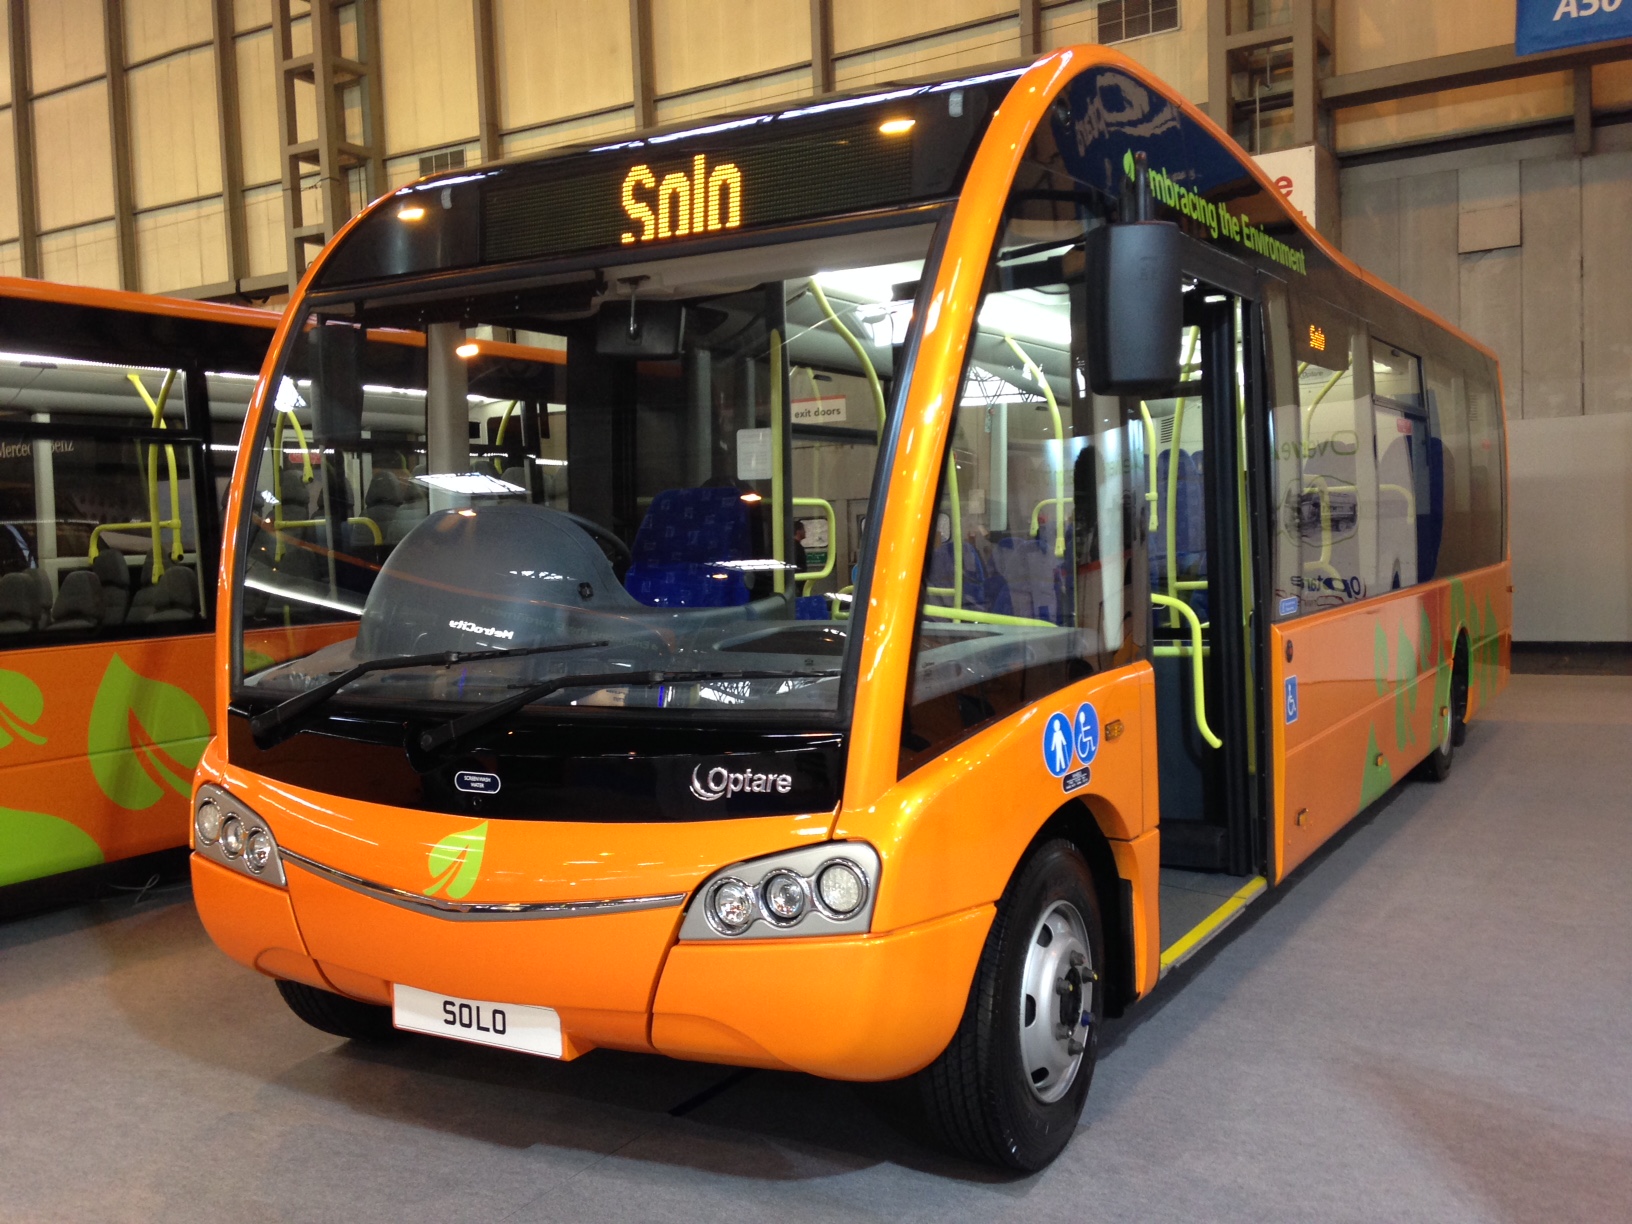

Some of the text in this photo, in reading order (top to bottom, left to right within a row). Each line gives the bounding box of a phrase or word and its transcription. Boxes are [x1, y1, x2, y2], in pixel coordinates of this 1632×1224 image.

[1148, 166, 1307, 276] mbracing the Environment
[794, 407, 841, 418] exit doors
[707, 766, 792, 798] Optare
[443, 1000, 506, 1035] SOLO
